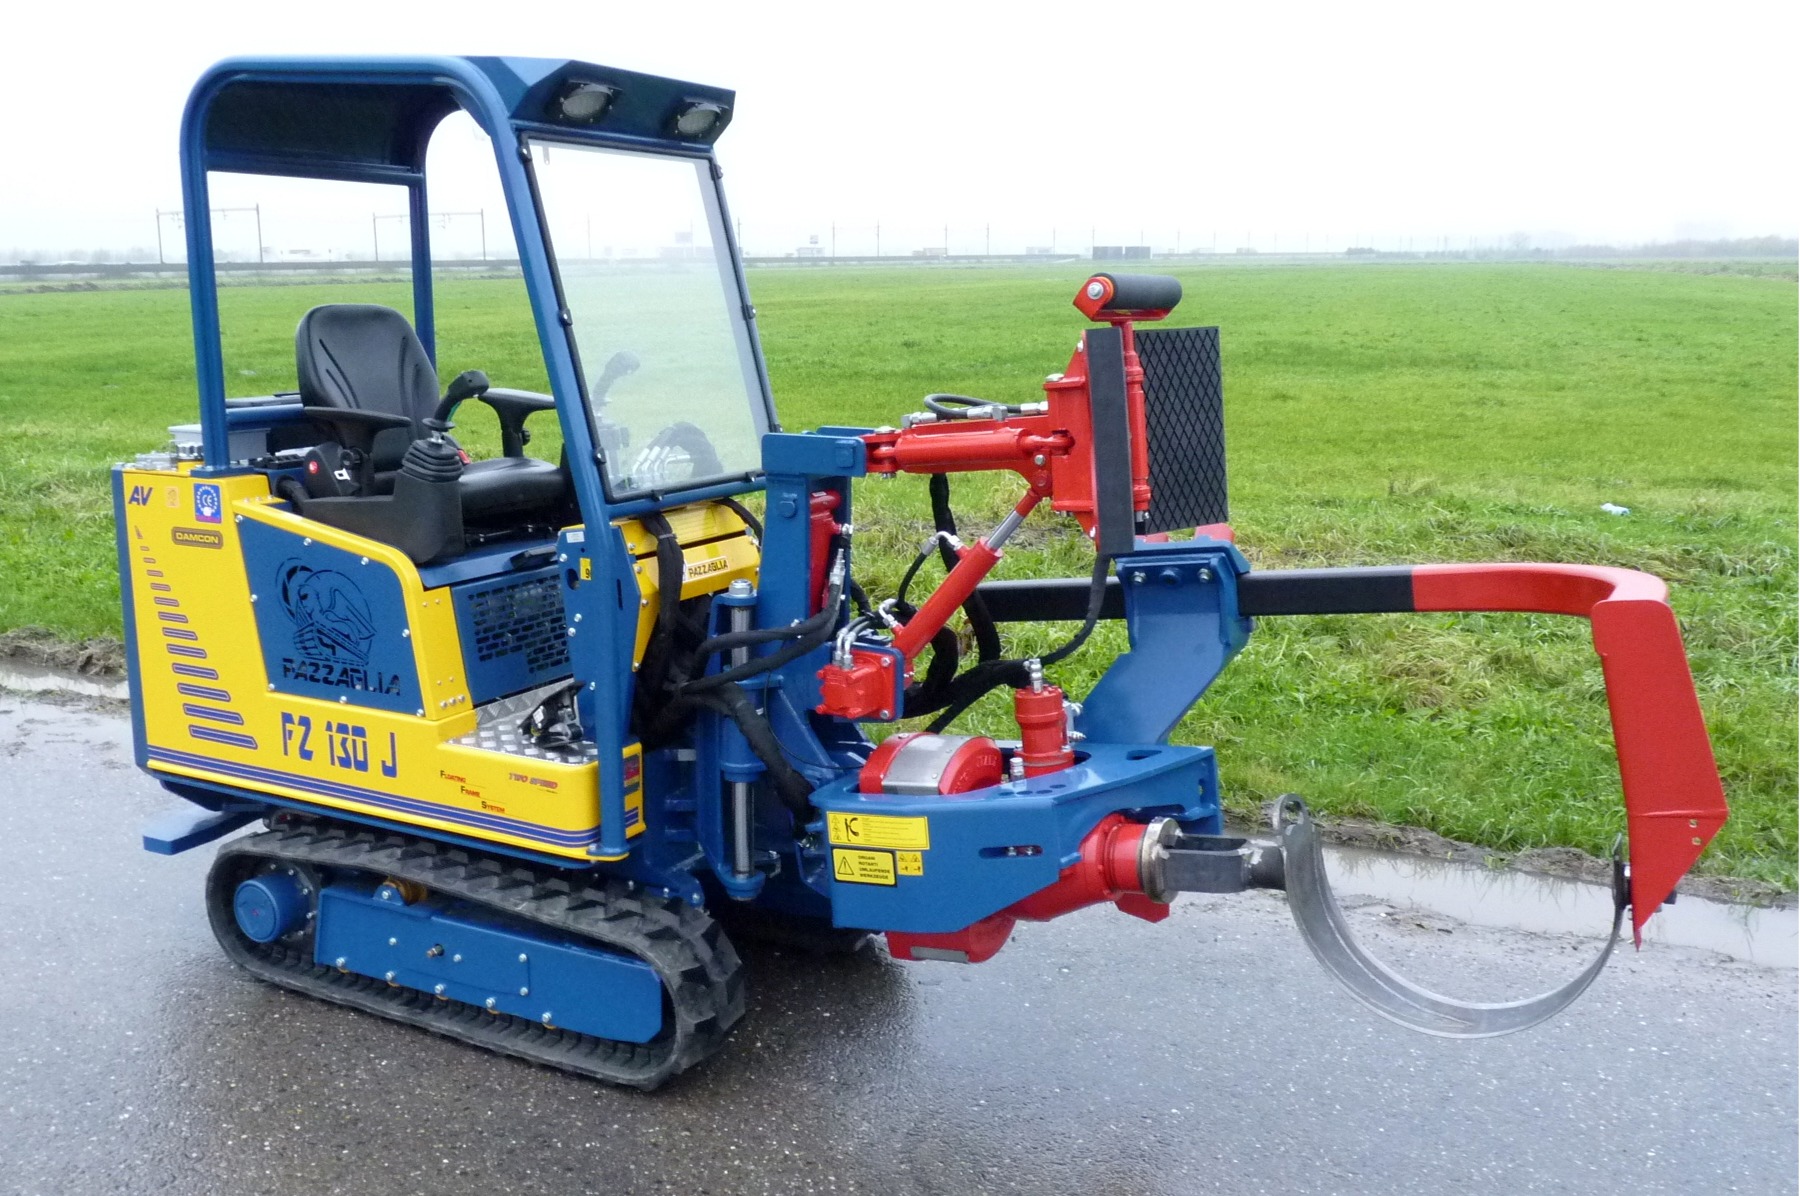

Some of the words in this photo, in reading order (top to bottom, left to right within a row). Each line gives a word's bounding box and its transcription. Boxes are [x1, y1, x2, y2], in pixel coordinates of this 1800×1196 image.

[128, 485, 153, 506] AV
[175, 532, 219, 544] DAMCON
[688, 560, 728, 578] PAZZAGLIA
[282, 657, 400, 696] PAZZAGLIA
[381, 732, 397, 778] J
